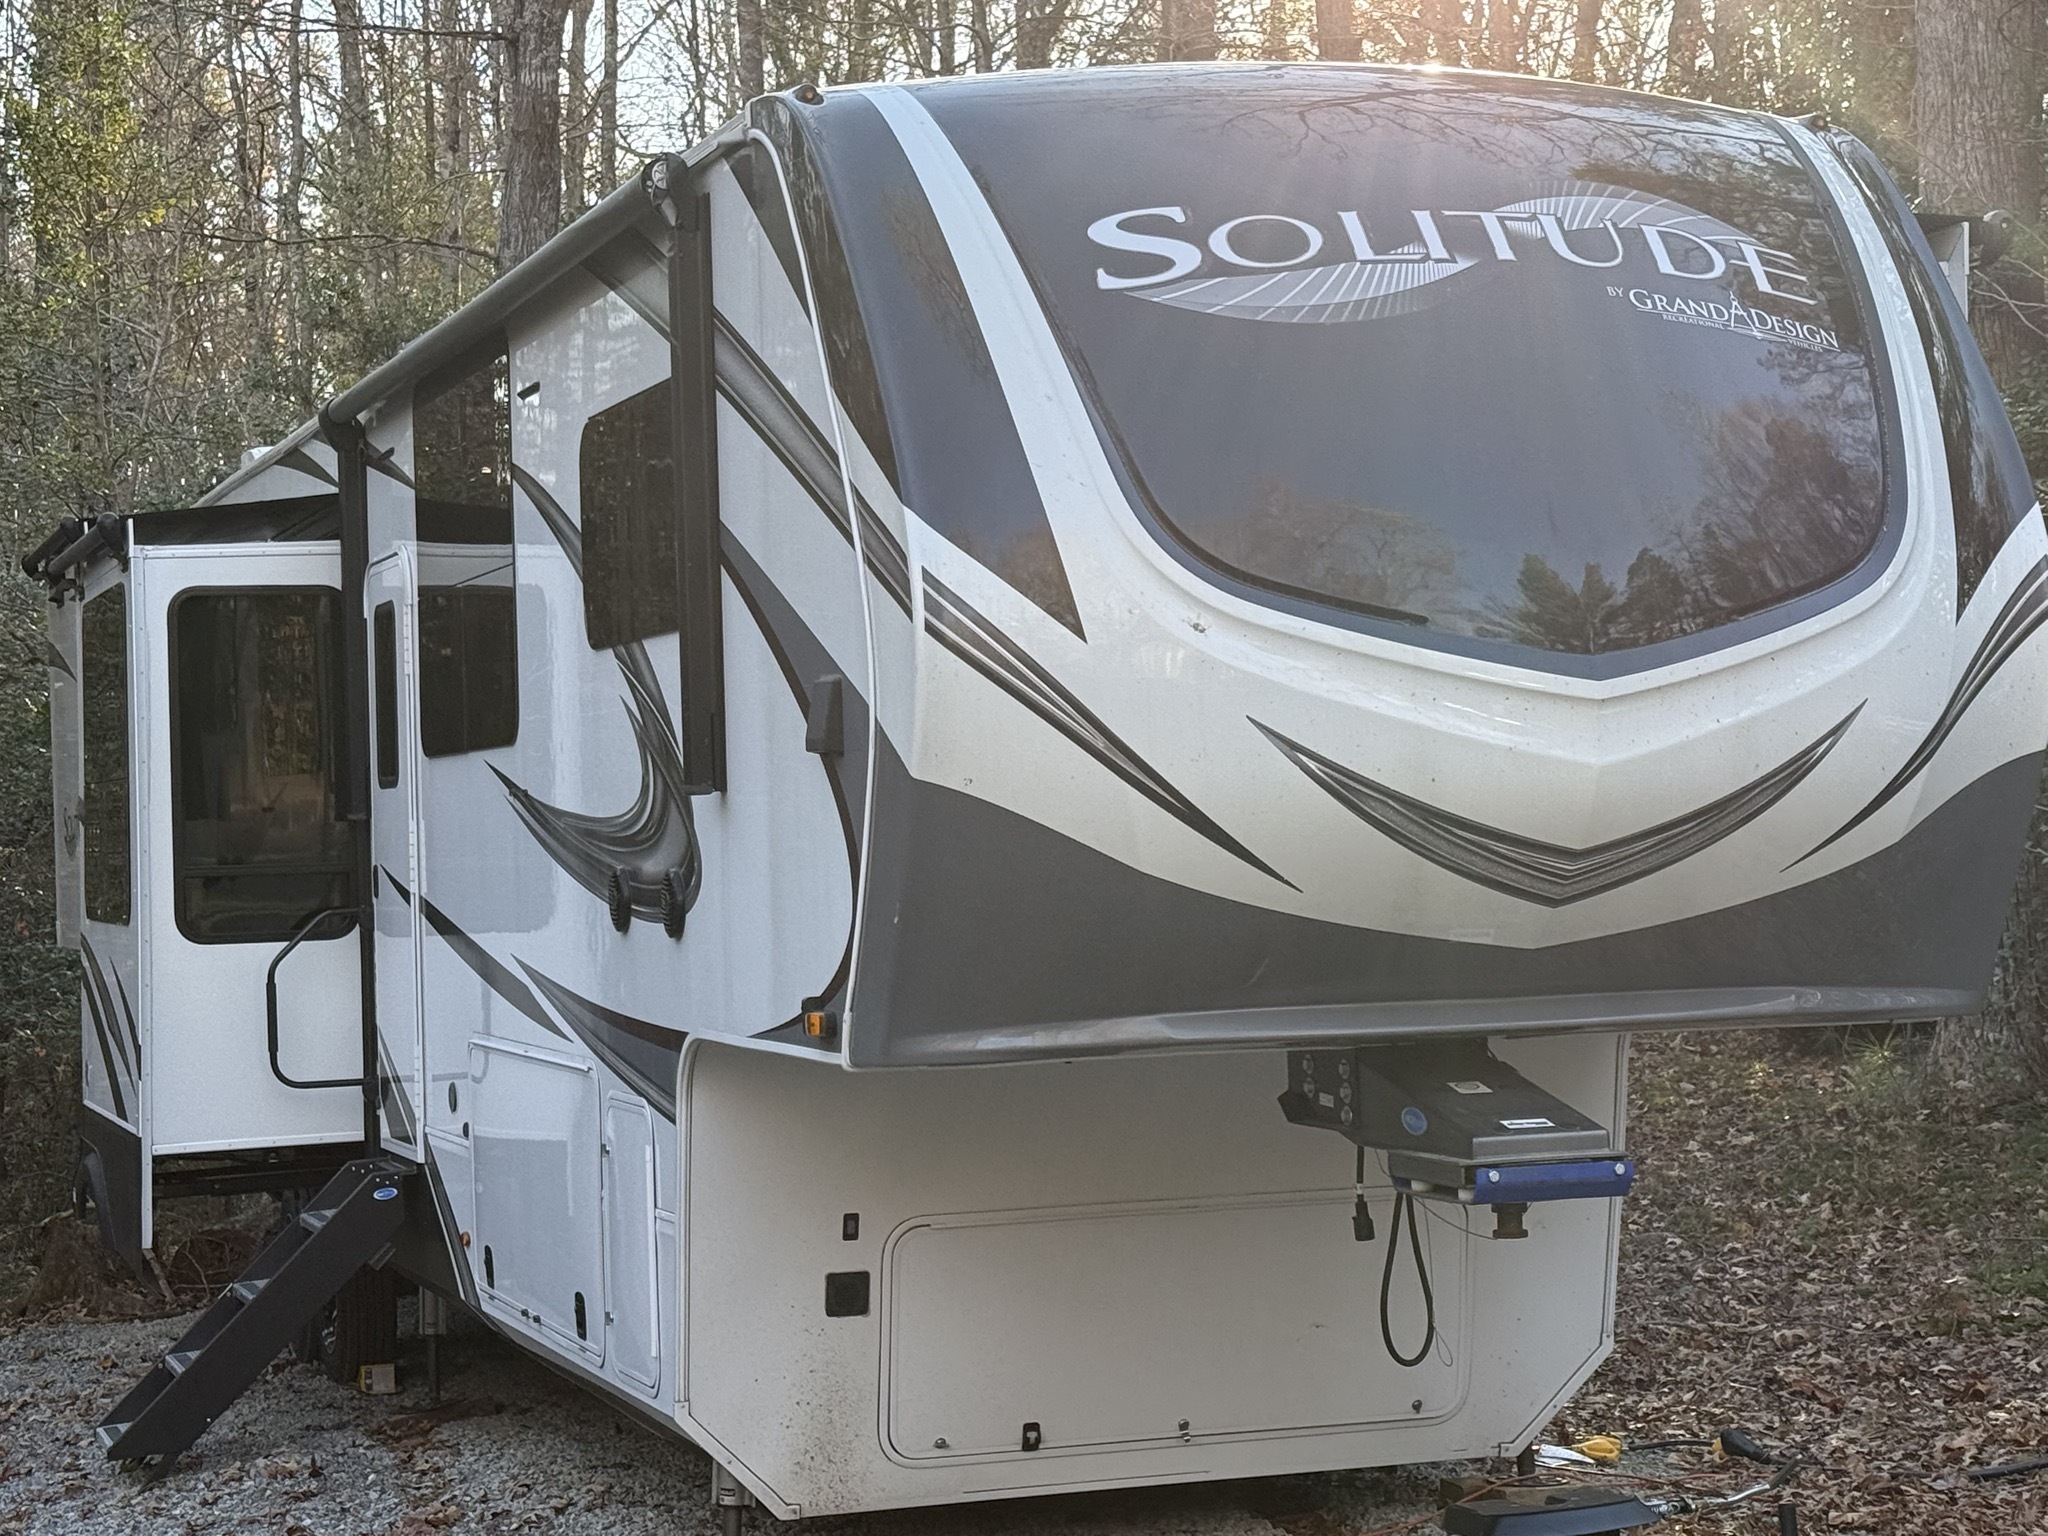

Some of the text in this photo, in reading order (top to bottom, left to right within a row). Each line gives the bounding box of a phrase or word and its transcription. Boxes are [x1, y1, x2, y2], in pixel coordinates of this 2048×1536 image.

[1086, 206, 1818, 305] SOLITUDE
[1606, 286, 1839, 349] BY GRAND DESIGN
